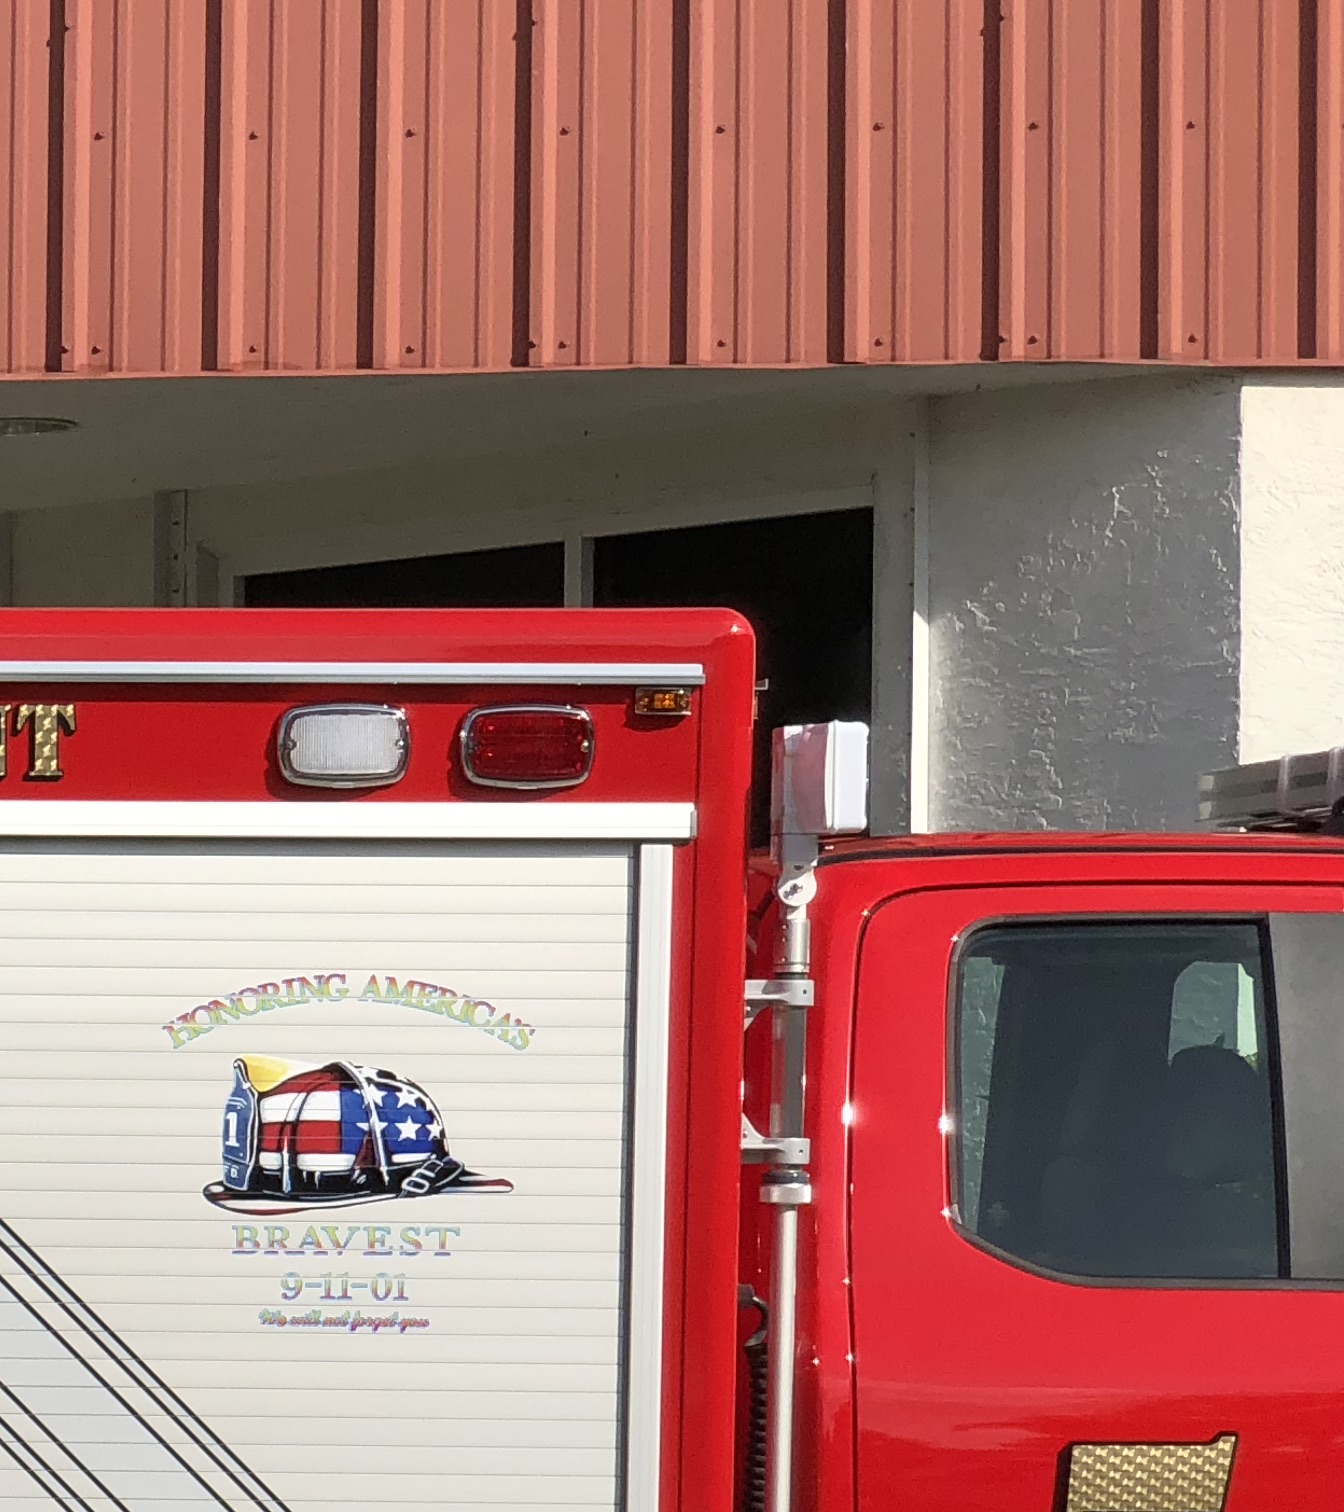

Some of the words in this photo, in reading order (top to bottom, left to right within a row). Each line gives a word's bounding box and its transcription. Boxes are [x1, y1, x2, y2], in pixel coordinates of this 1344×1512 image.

[161, 973, 350, 1050] HONORING
[231, 1224, 461, 1257] BRAVEST
[280, 1271, 409, 1302] 9-11-01
